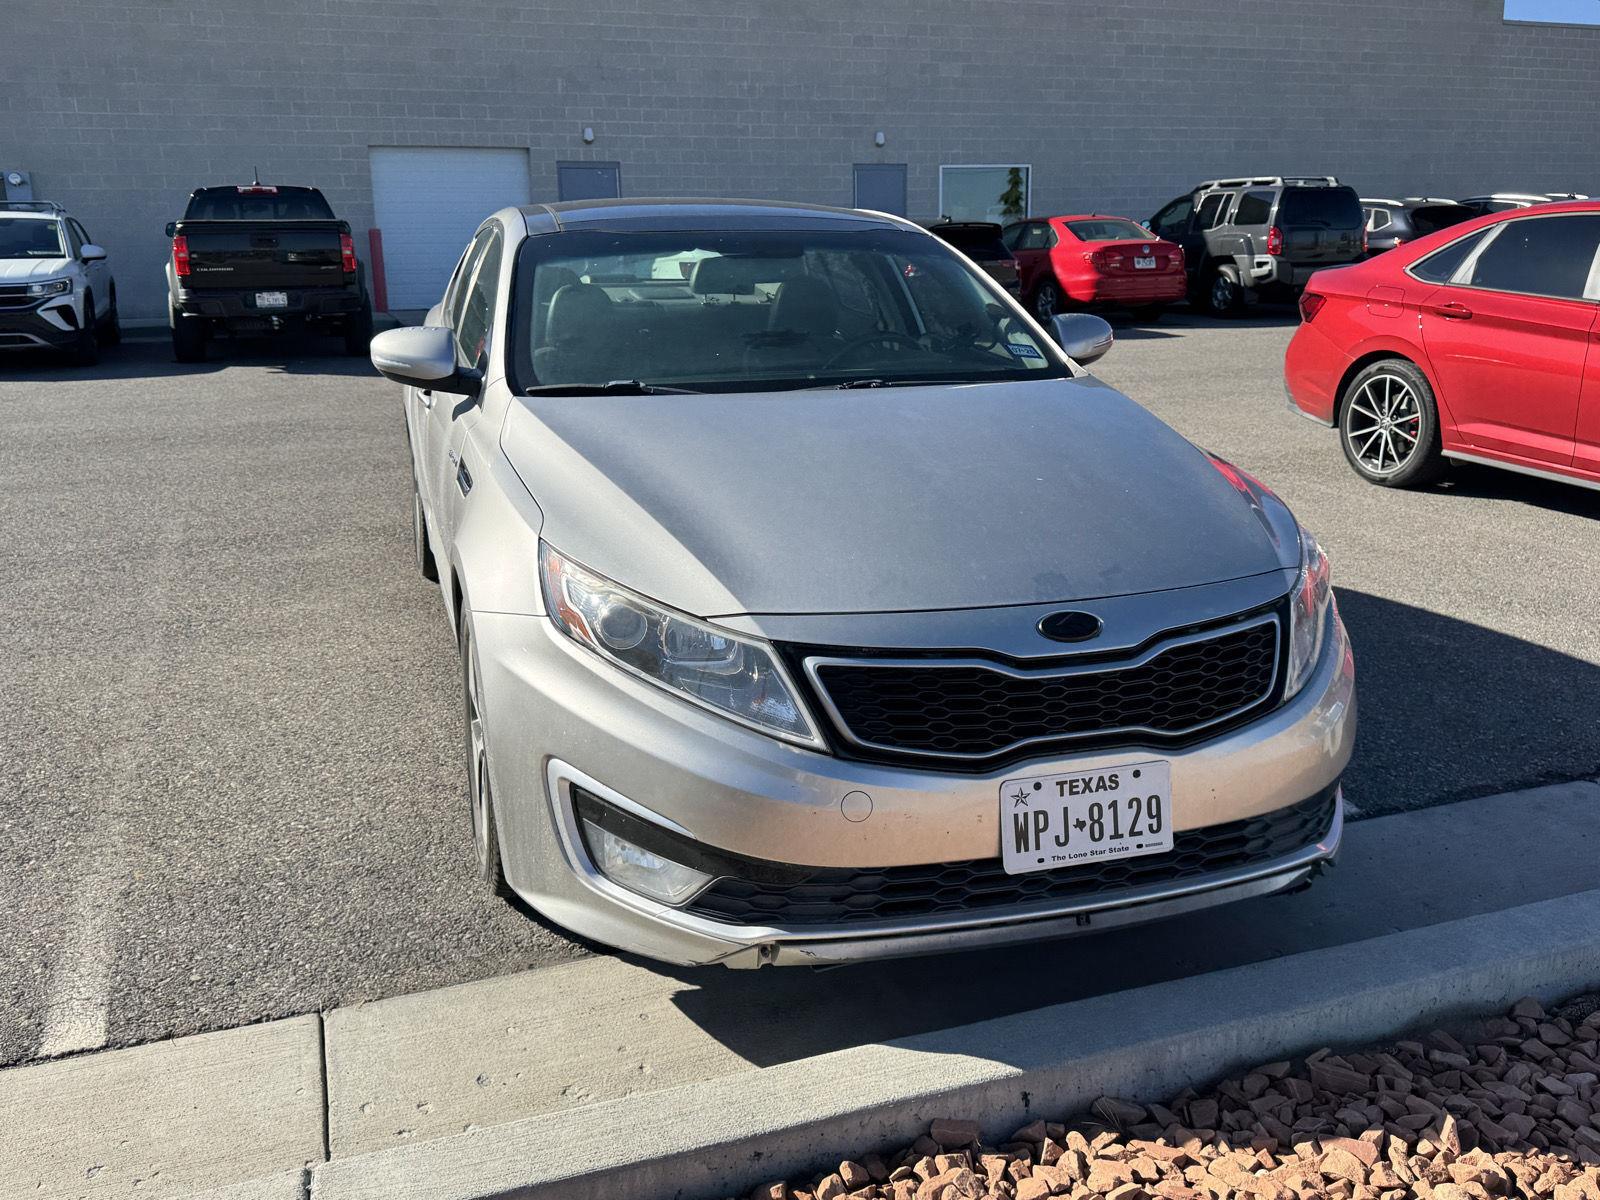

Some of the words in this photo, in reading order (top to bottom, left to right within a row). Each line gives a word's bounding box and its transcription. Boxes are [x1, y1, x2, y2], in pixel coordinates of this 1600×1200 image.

[1055, 774, 1120, 797] TEXAS
[1013, 806, 1070, 854] WPJ
[1088, 794, 1163, 843] 8129
[1051, 854, 1067, 862] The
[1068, 851, 1088, 860] Lone
[1090, 849, 1107, 857] Star
[1108, 845, 1130, 854] State
